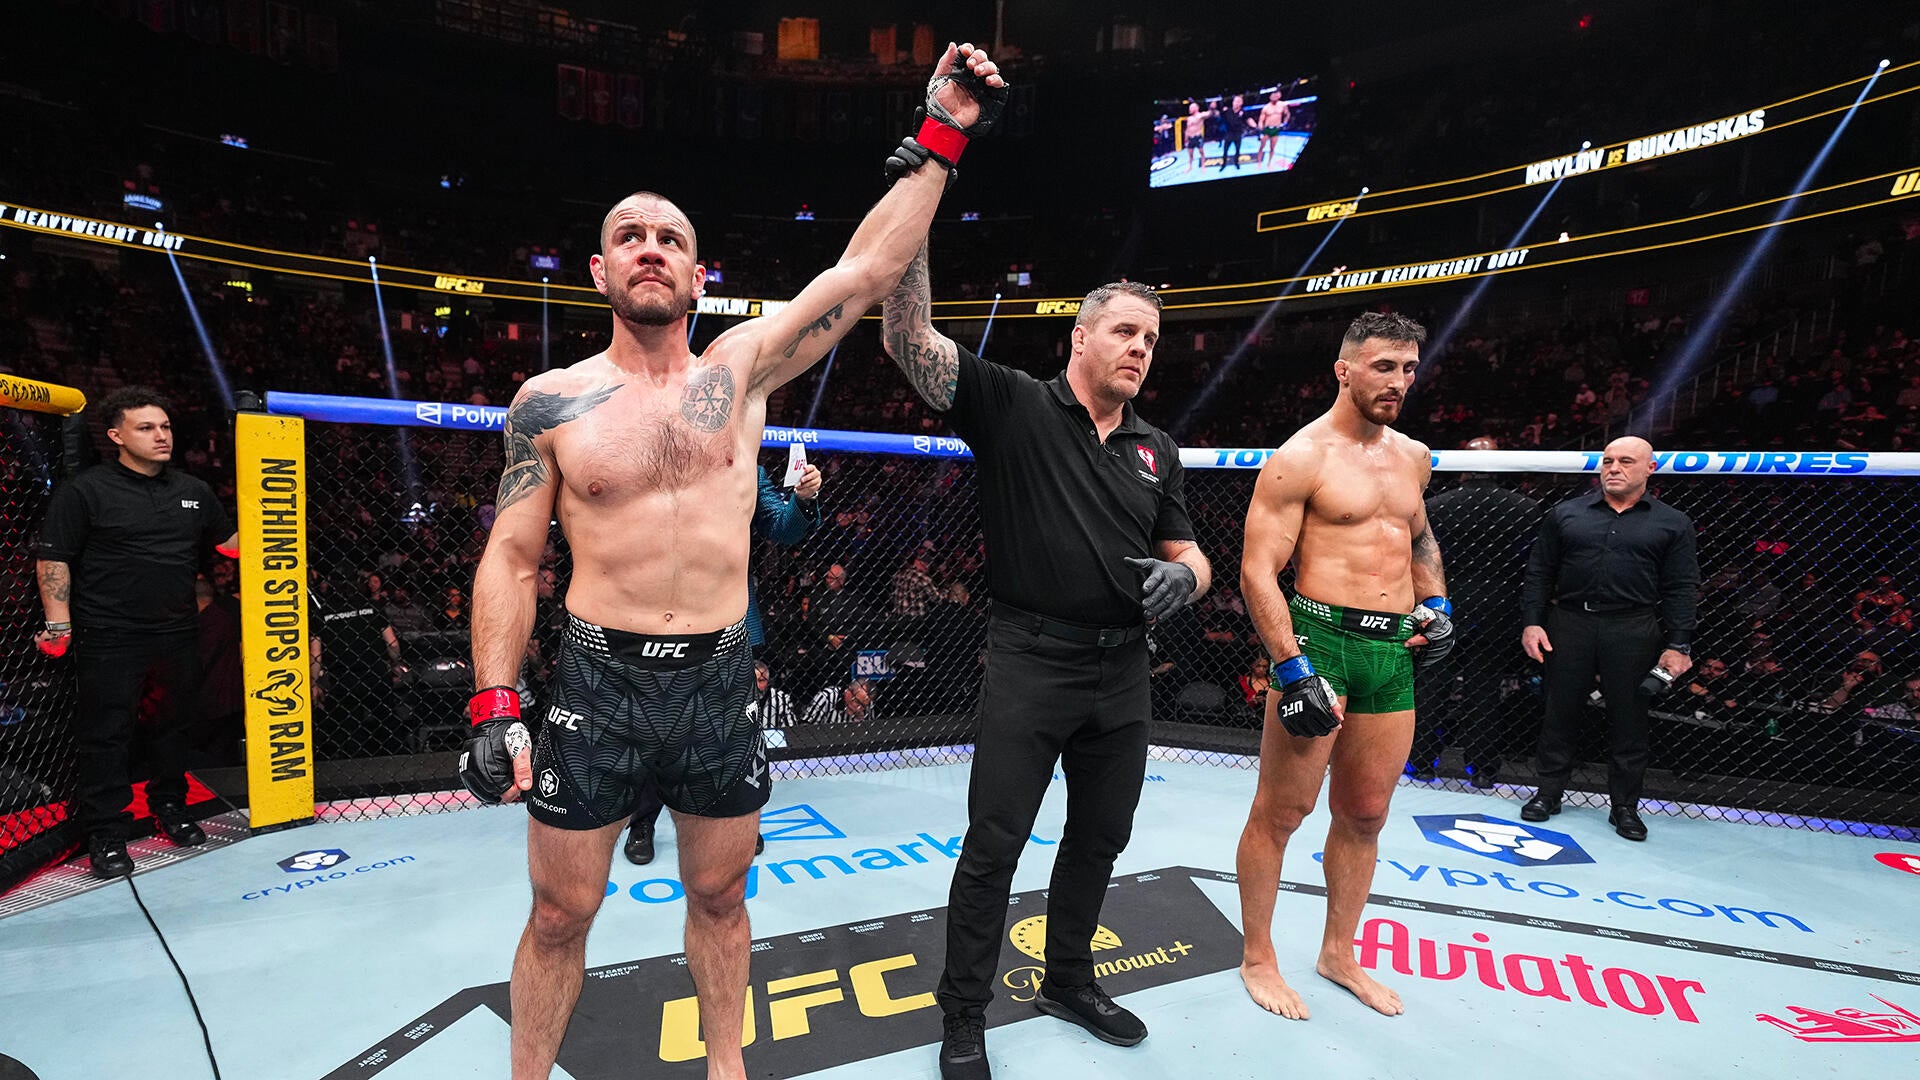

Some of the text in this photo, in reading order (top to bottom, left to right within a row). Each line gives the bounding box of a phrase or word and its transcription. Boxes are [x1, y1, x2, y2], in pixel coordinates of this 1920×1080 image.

[1525, 148, 1605, 185] KRYLOV
[1626, 109, 1766, 163] BUKAUSKAS
[14, 208, 137, 242] HEAVYWEIGHT
[142, 231, 184, 250] BOUT
[1306, 249, 1529, 292] UFC LIGHT HEAVYWEIGHT BOUT
[28, 384, 51, 403] RAM
[936, 438, 970, 455] Poly
[1718, 452, 1869, 473] TIRES
[181, 499, 200, 509] UFC
[260, 457, 307, 782] NOTHING STOPS RAM
[324, 608, 374, 621] PRDUCION
[1360, 614, 1391, 630] UFC
[641, 641, 690, 659] UFC
[548, 705, 584, 731] UFC
[1281, 700, 1304, 718] UFC
[241, 854, 416, 901] crypto.com
[1312, 851, 1815, 934] ypto.com
[599, 971, 630, 979] FAMILY
[1353, 918, 1707, 1023] Aviator
[658, 953, 937, 1062] UFC
[410, 1024, 434, 1040] RILEY
[358, 1048, 387, 1068] JASON
